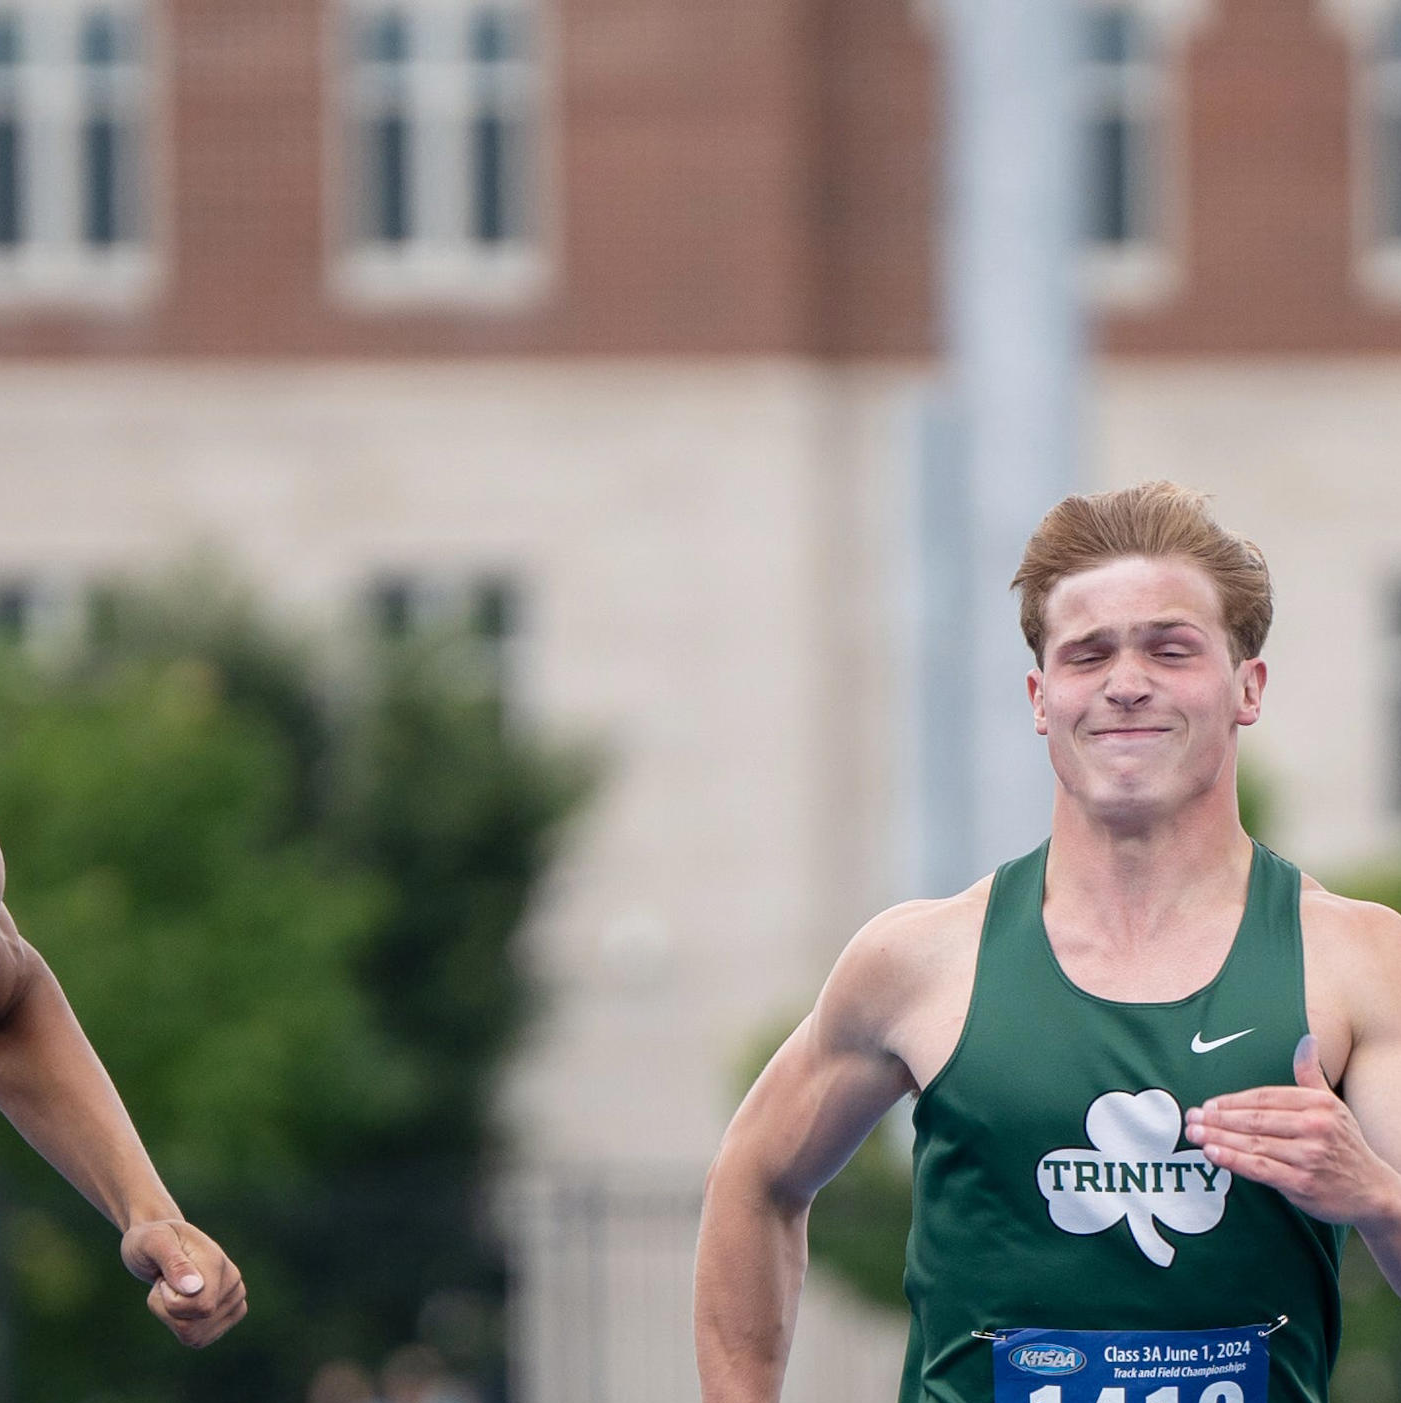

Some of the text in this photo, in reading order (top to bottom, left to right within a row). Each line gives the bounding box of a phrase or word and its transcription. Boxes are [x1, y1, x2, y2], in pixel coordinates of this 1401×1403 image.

[1043, 1160, 1221, 1193] TRINITY
[1019, 1349, 1076, 1368] KHSAA
[1104, 1340, 1251, 1363] Class 3A June 1, 2024
[1114, 1361, 1247, 1379] Track and Field Championships
